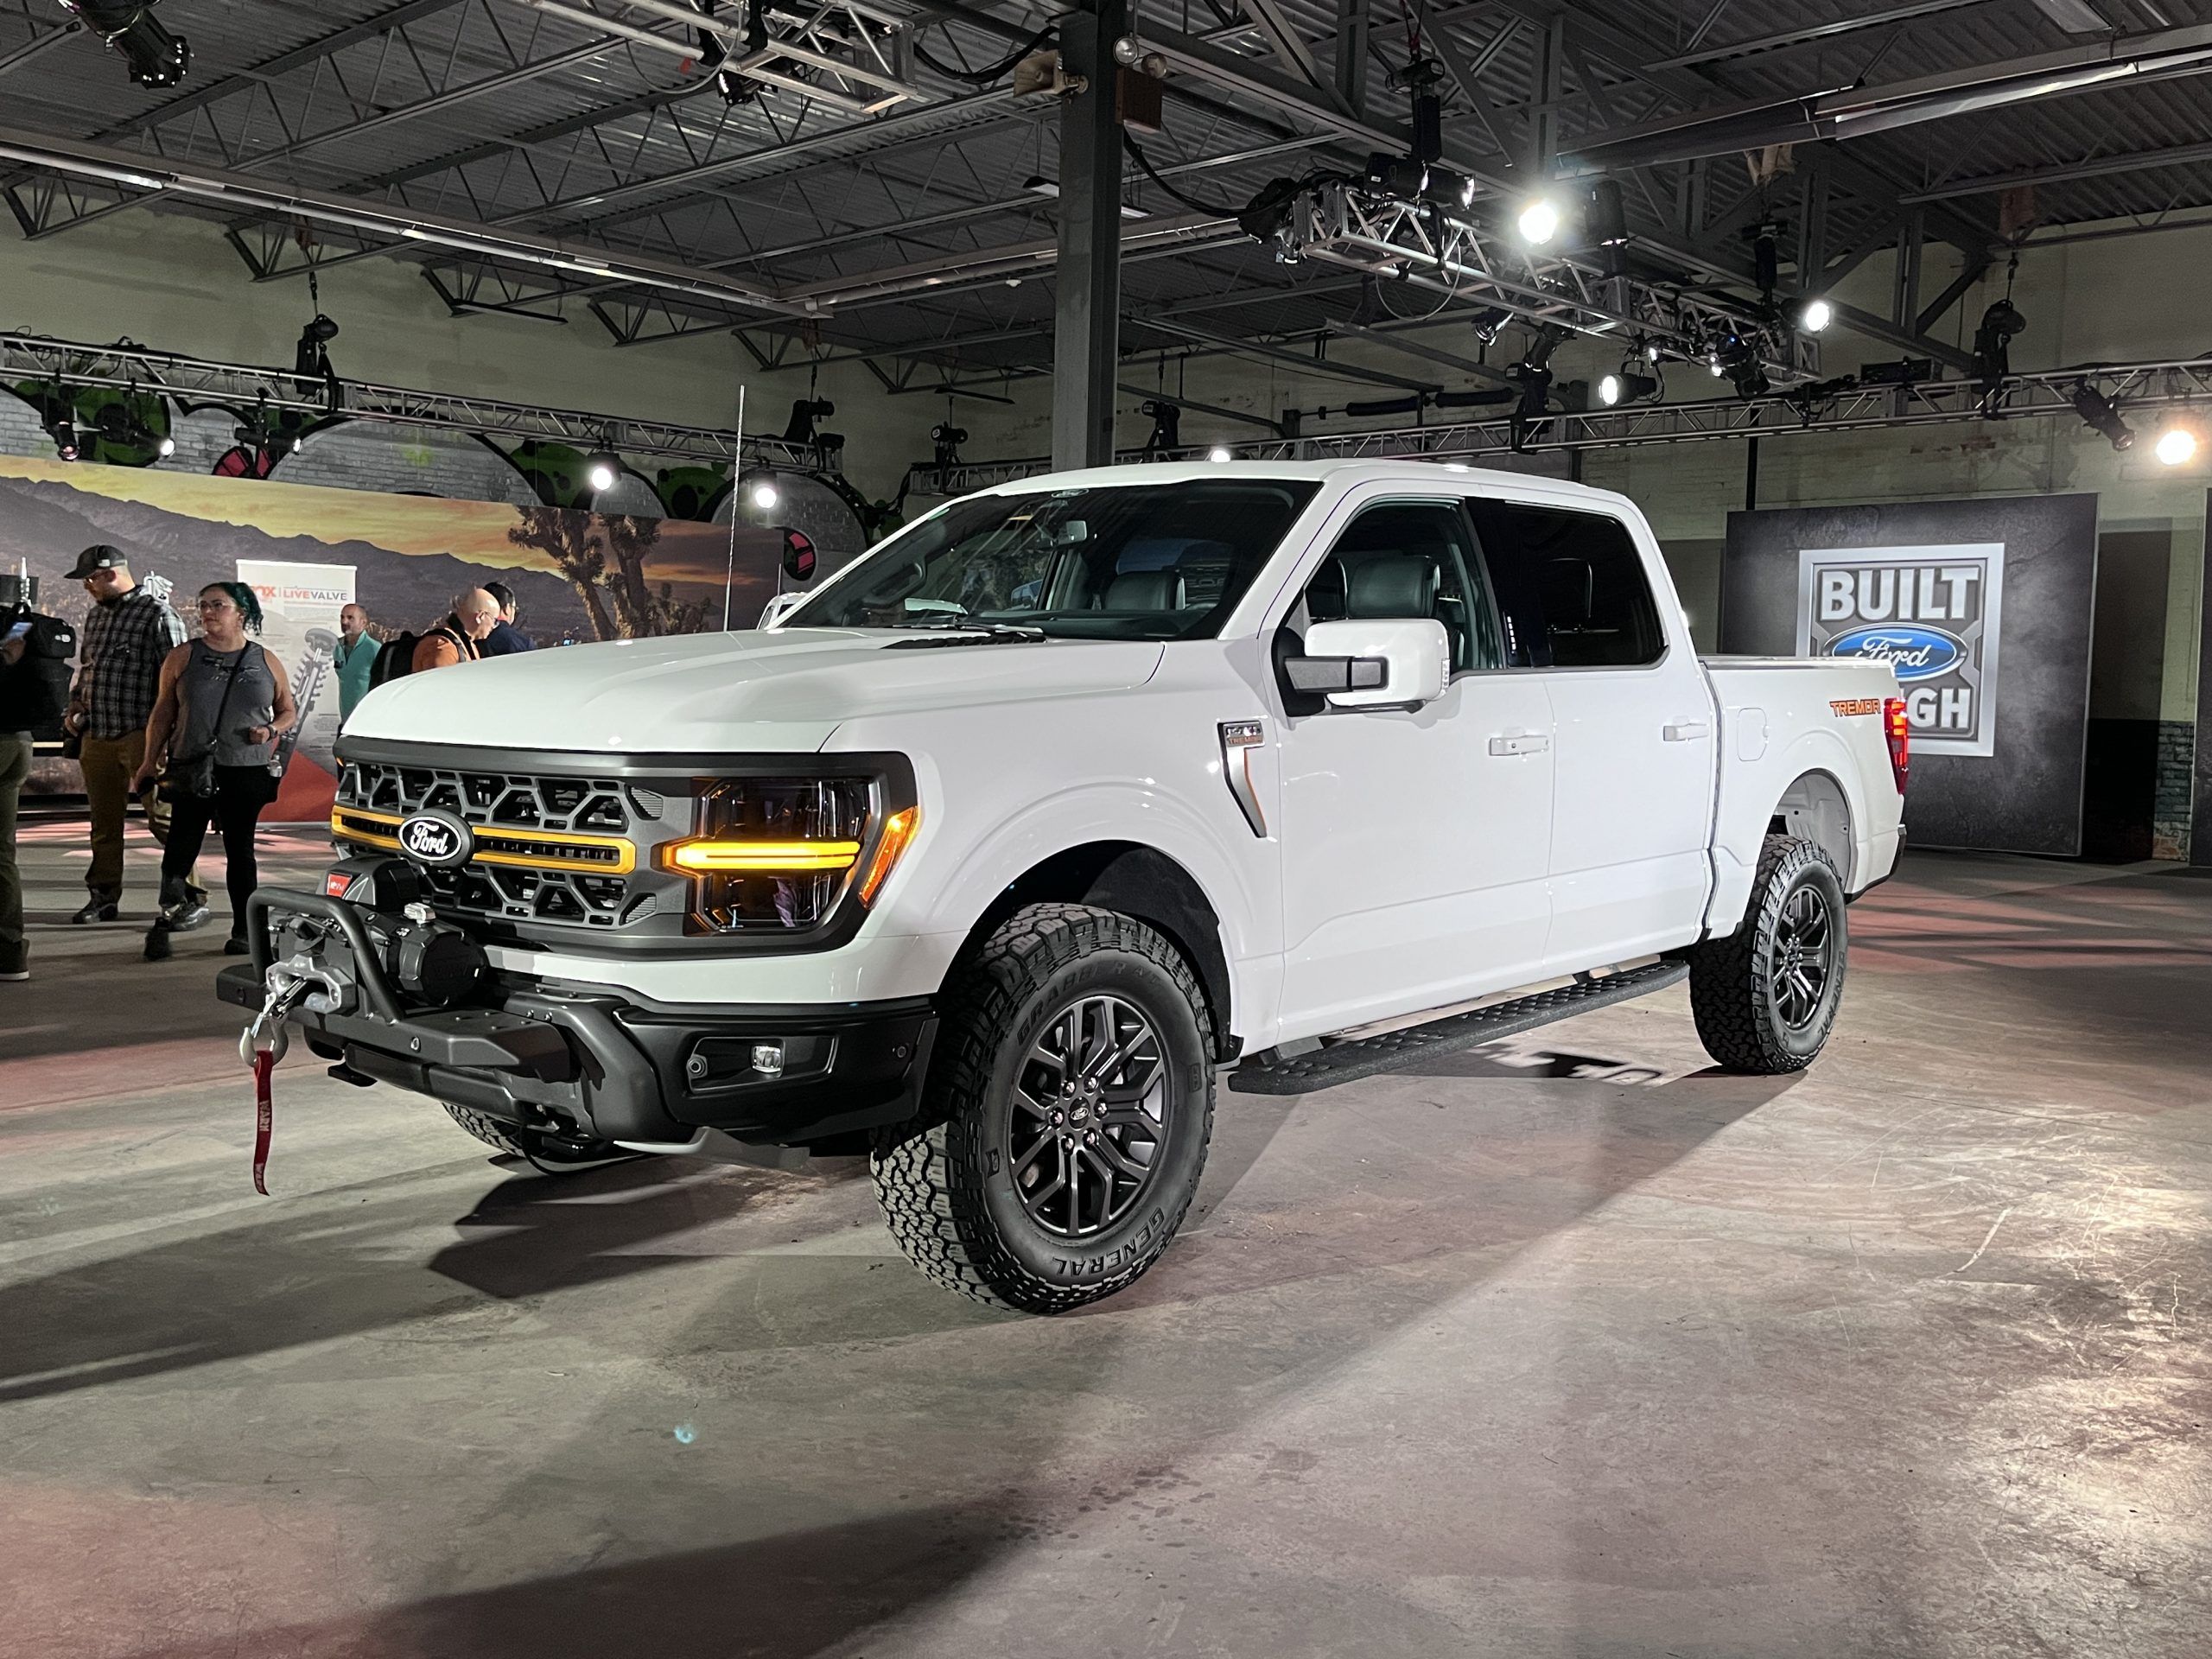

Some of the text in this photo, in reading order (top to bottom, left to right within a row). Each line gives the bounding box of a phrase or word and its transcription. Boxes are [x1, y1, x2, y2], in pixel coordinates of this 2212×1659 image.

[1820, 567, 1979, 621] BUILT
[1854, 636, 1932, 668] Ford
[1828, 698, 1882, 718] TREMOR
[410, 821, 449, 855] Ford
[1052, 1206, 1166, 1276] GENERAL
